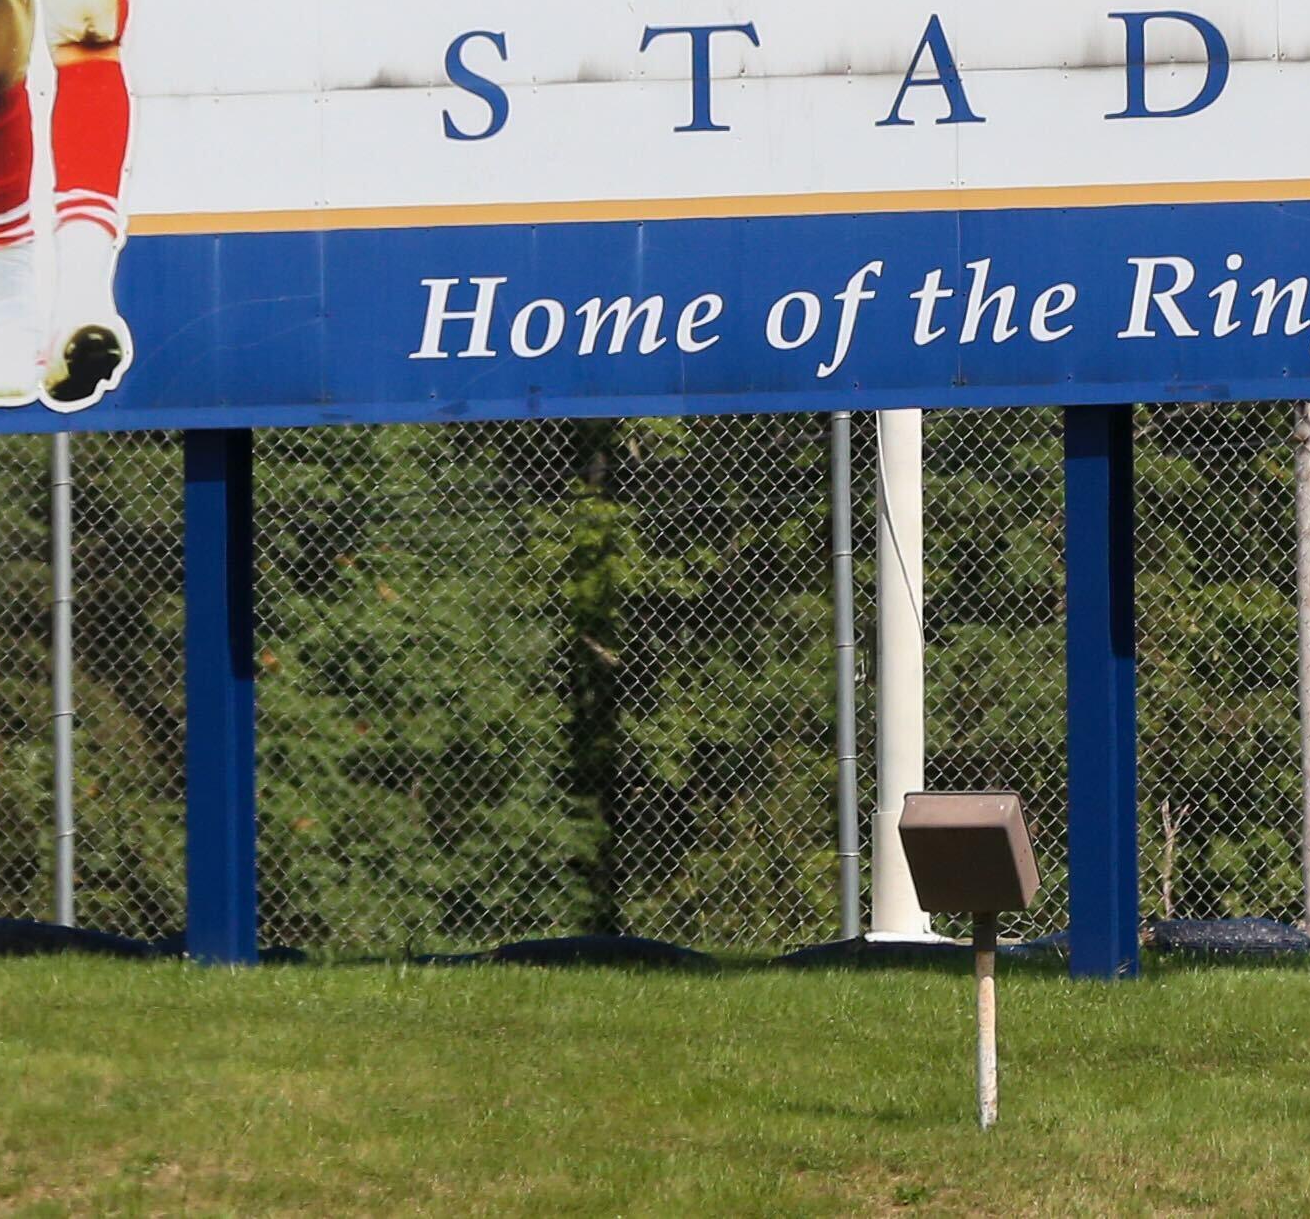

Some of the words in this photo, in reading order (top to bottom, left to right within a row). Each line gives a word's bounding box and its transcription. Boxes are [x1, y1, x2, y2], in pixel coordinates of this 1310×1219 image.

[408, 275, 725, 360] Home
[765, 260, 884, 378] of
[910, 257, 1078, 346] the
